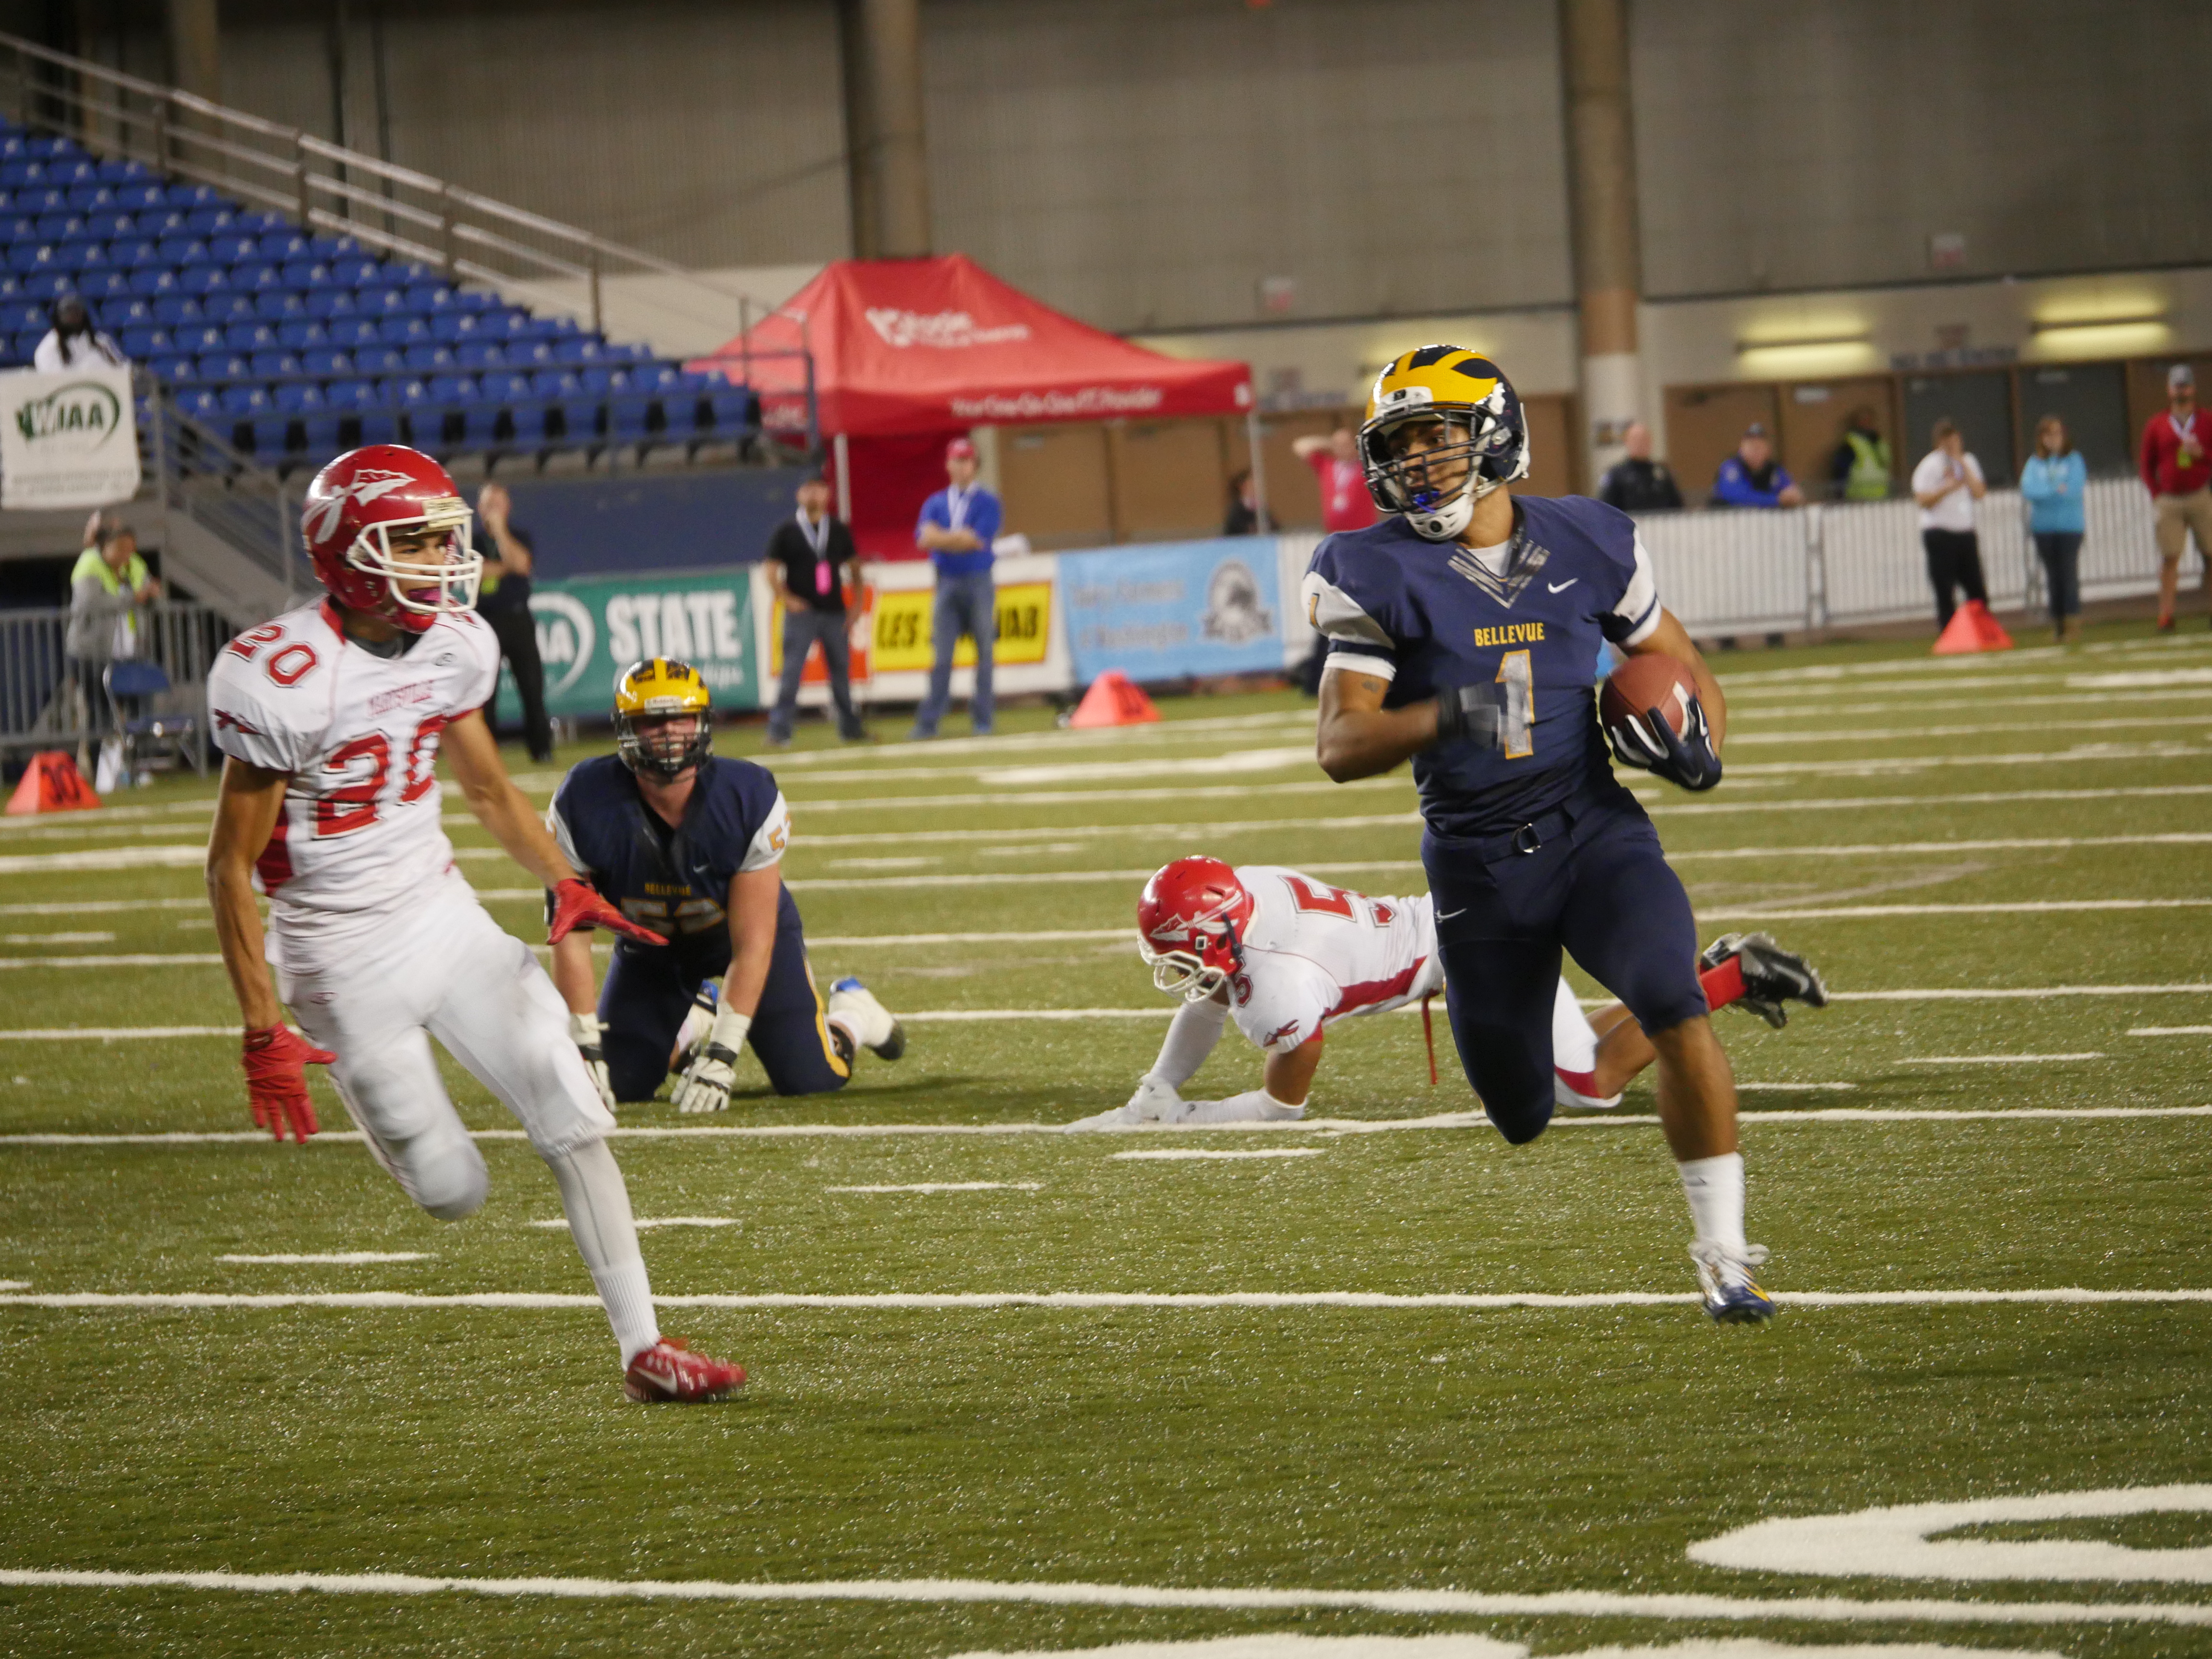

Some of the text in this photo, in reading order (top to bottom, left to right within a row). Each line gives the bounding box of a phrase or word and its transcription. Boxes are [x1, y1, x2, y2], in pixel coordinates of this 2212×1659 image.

[225, 623, 322, 689] 20
[606, 590, 742, 664] STATE
[1474, 622, 1546, 647] BELLEVUE
[1494, 649, 1535, 759] 1
